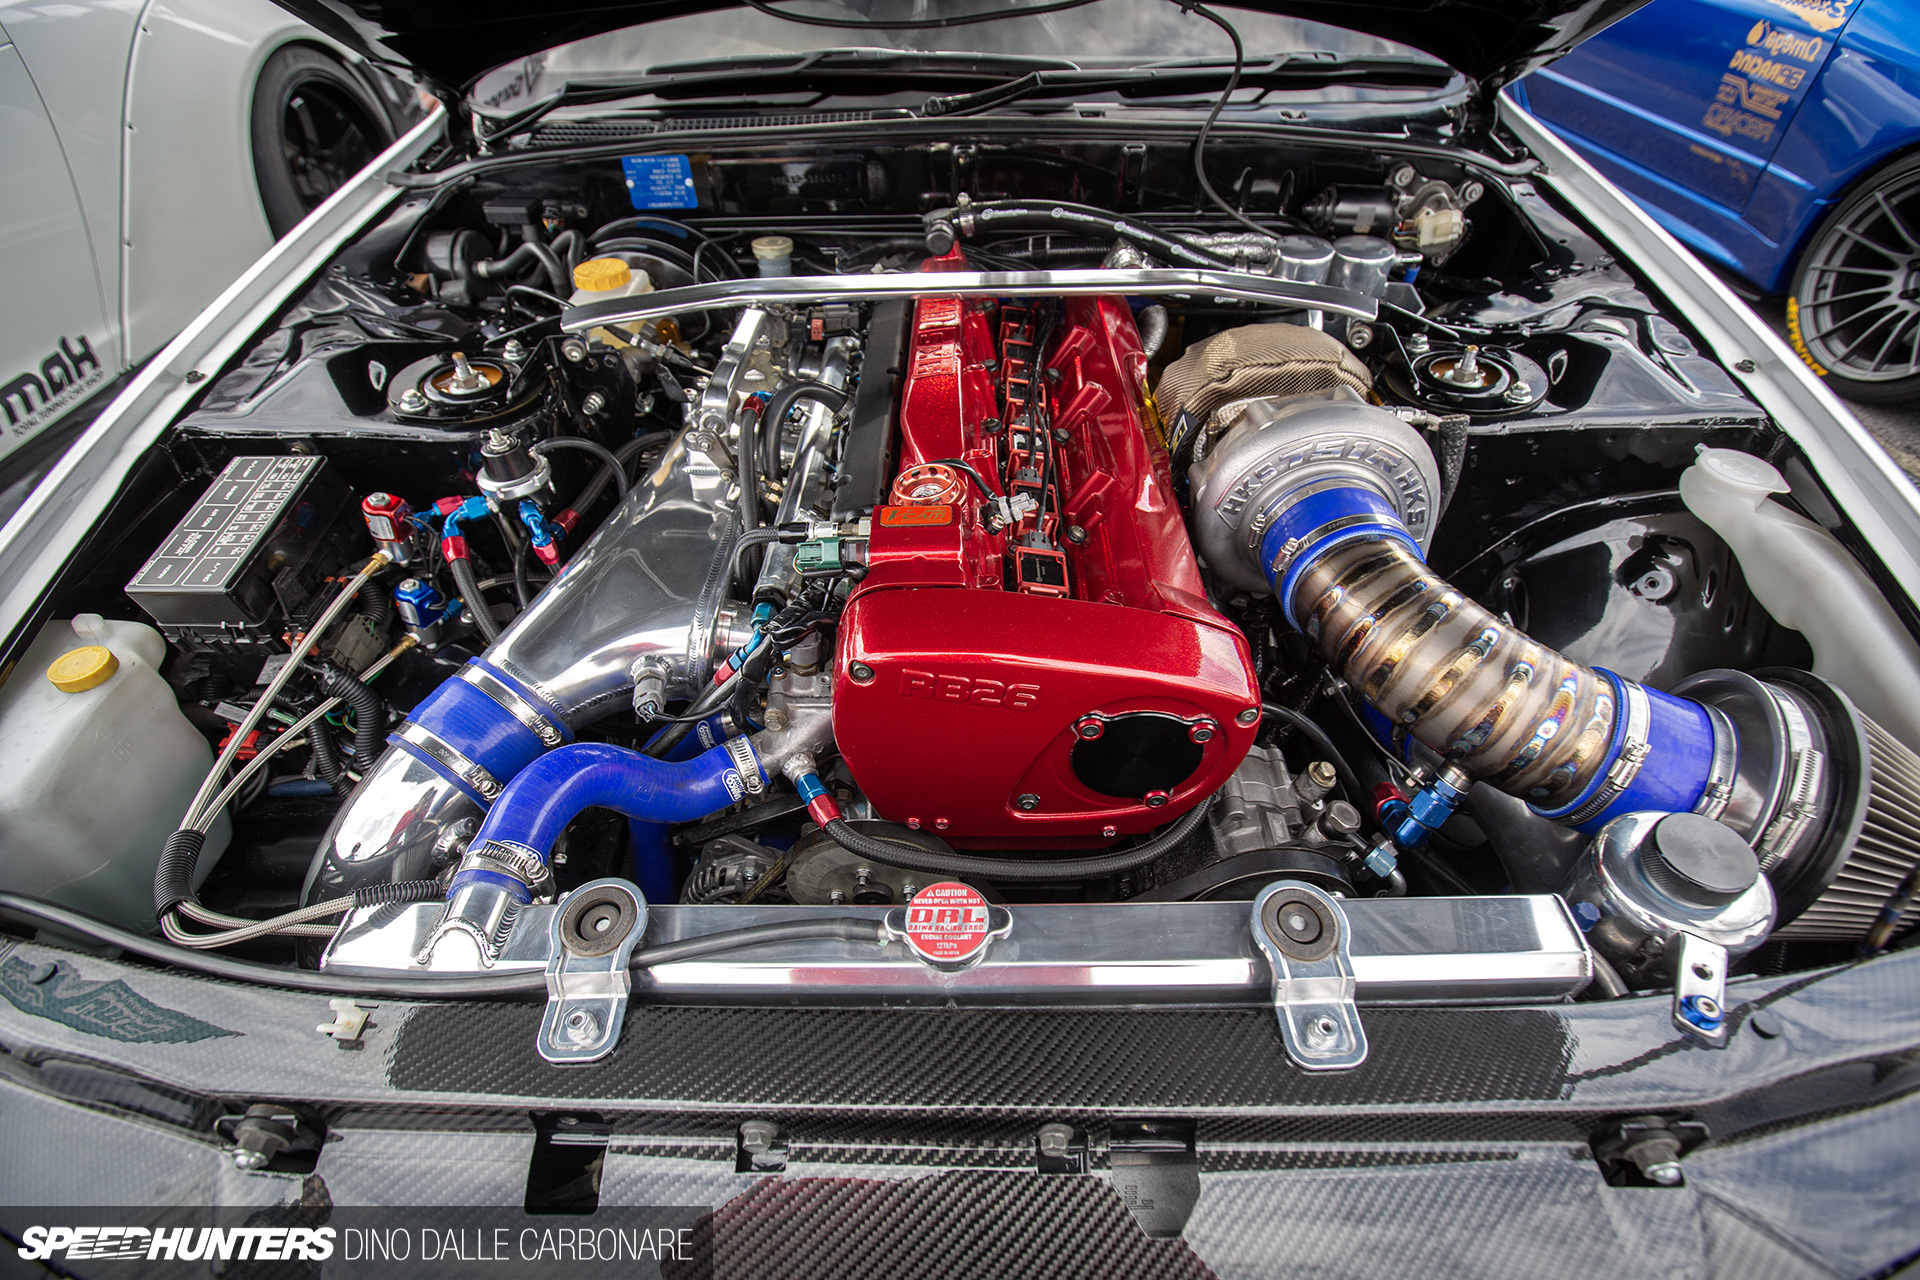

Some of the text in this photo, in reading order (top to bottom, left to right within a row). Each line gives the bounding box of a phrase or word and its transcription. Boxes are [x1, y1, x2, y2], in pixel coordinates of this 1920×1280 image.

[1223, 462, 1278, 515] HKS
[1395, 468, 1426, 526] HKS
[900, 668, 1040, 711] RB26
[935, 889, 967, 897] CAUTION
[909, 908, 984, 924] DRL
